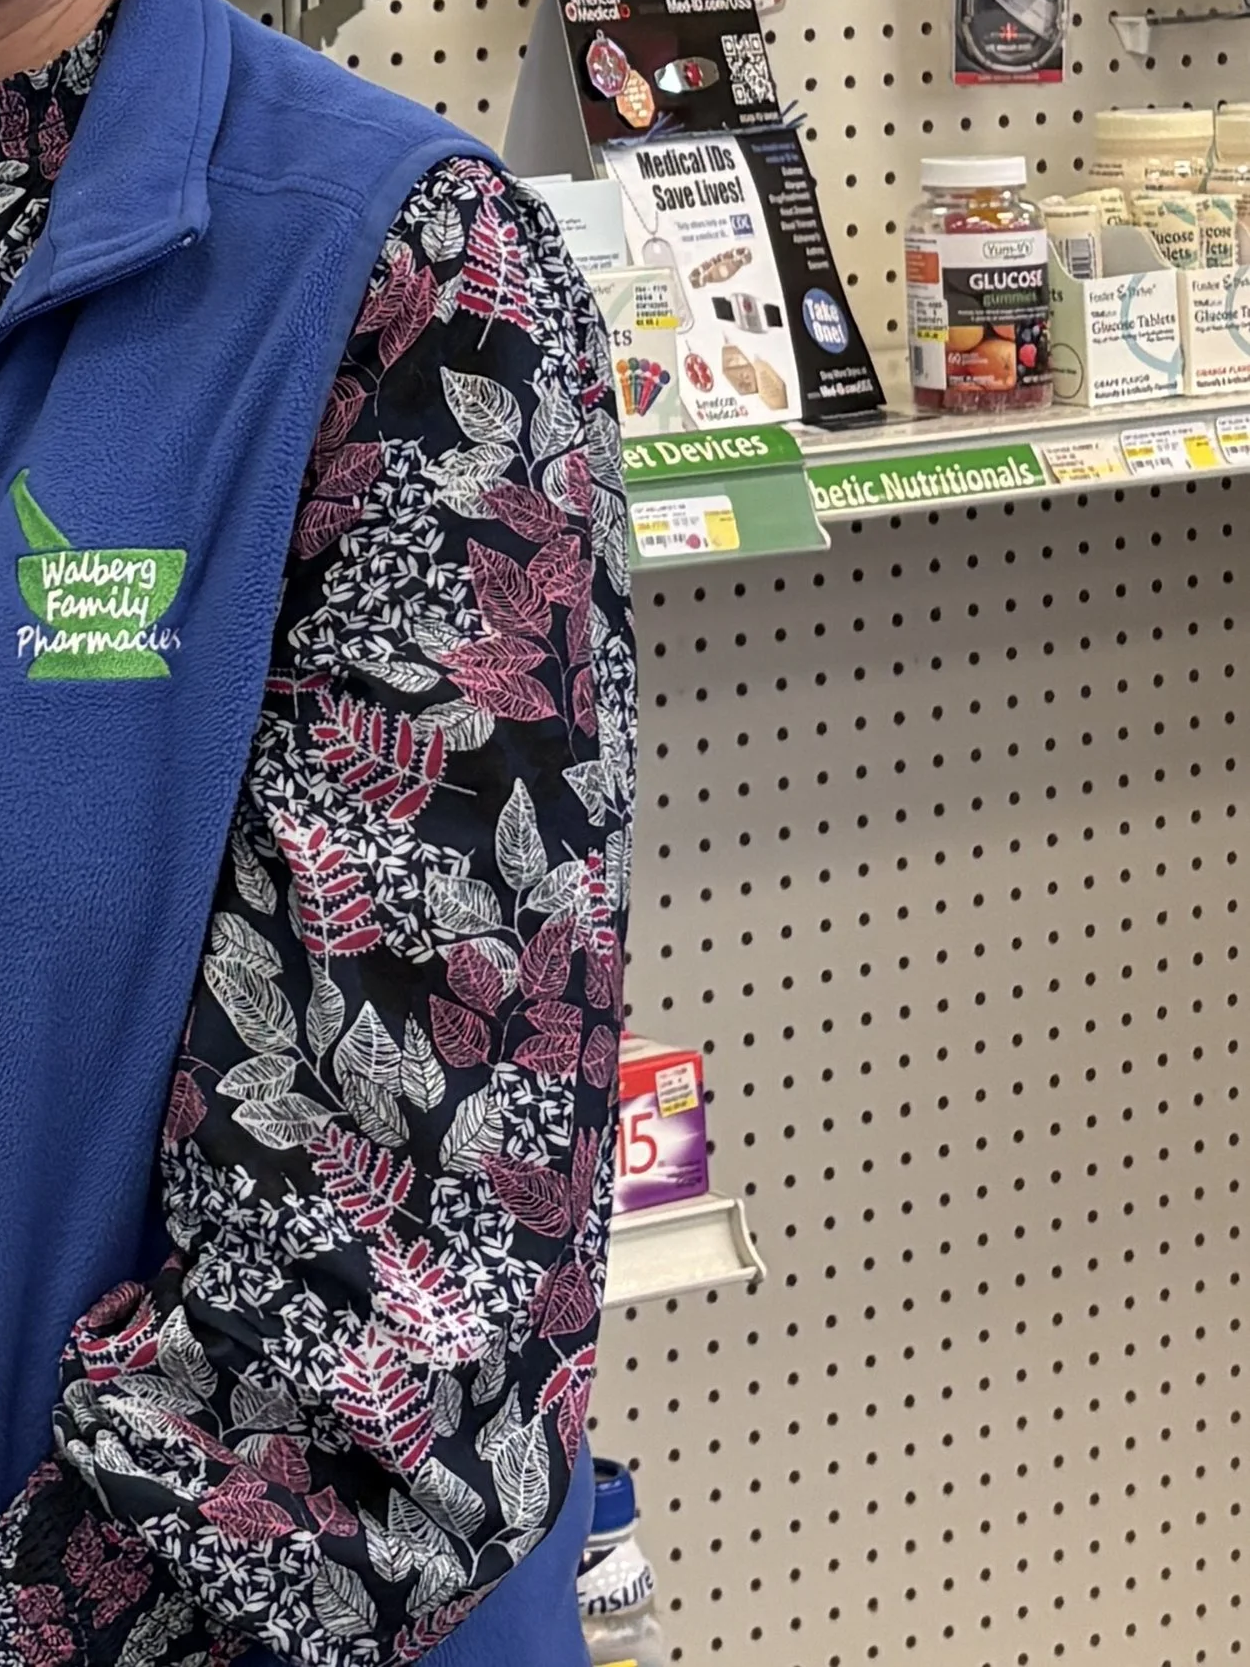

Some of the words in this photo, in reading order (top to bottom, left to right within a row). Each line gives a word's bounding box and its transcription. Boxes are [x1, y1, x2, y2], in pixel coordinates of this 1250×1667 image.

[578, 5, 621, 22] Medical
[636, 145, 704, 180] Medical
[706, 143, 736, 172] IDs
[652, 183, 695, 212] Save
[699, 176, 746, 208] Lives!
[969, 269, 1043, 291] GLUCOSE
[805, 298, 840, 323] Take
[982, 290, 1038, 308] gummies
[1195, 308, 1238, 323] Glucose
[812, 321, 845, 346] One!
[1092, 319, 1136, 335] Glucose
[1137, 312, 1176, 328] Tablets
[656, 433, 769, 467] Devices
[811, 473, 879, 509] betic
[880, 457, 1036, 504] Nutritionals
[42, 551, 156, 590] Walberg
[47, 585, 149, 627] Family
[16, 623, 182, 659] Pharmacies
[619, 1111, 657, 1178] 15
